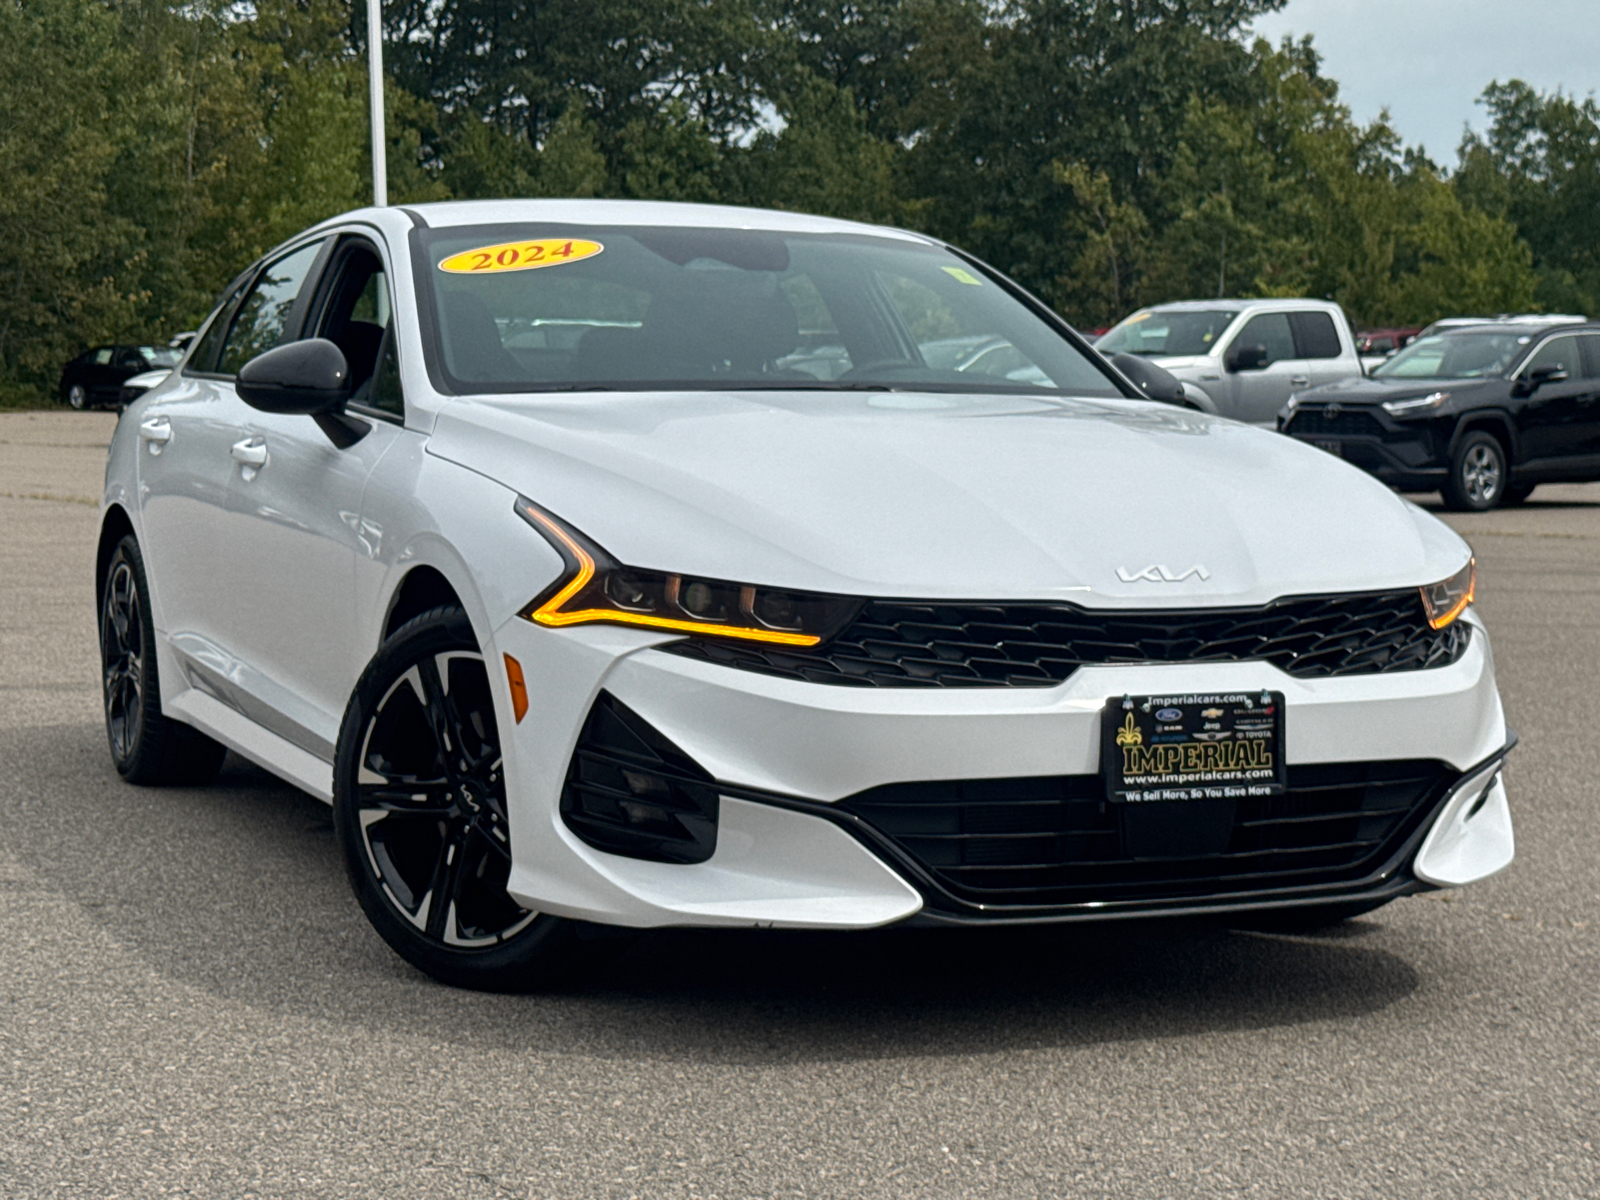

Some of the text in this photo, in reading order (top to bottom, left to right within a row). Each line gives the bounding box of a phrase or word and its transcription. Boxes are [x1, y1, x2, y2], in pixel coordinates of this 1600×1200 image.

[470, 241, 575, 271] 2024
[1203, 722, 1221, 730] Jeep
[1123, 740, 1273, 775] IMPERIAL
[1123, 769, 1273, 785] www.imperialcars.com
[1125, 786, 1271, 802] We Sell More, So You Save More
